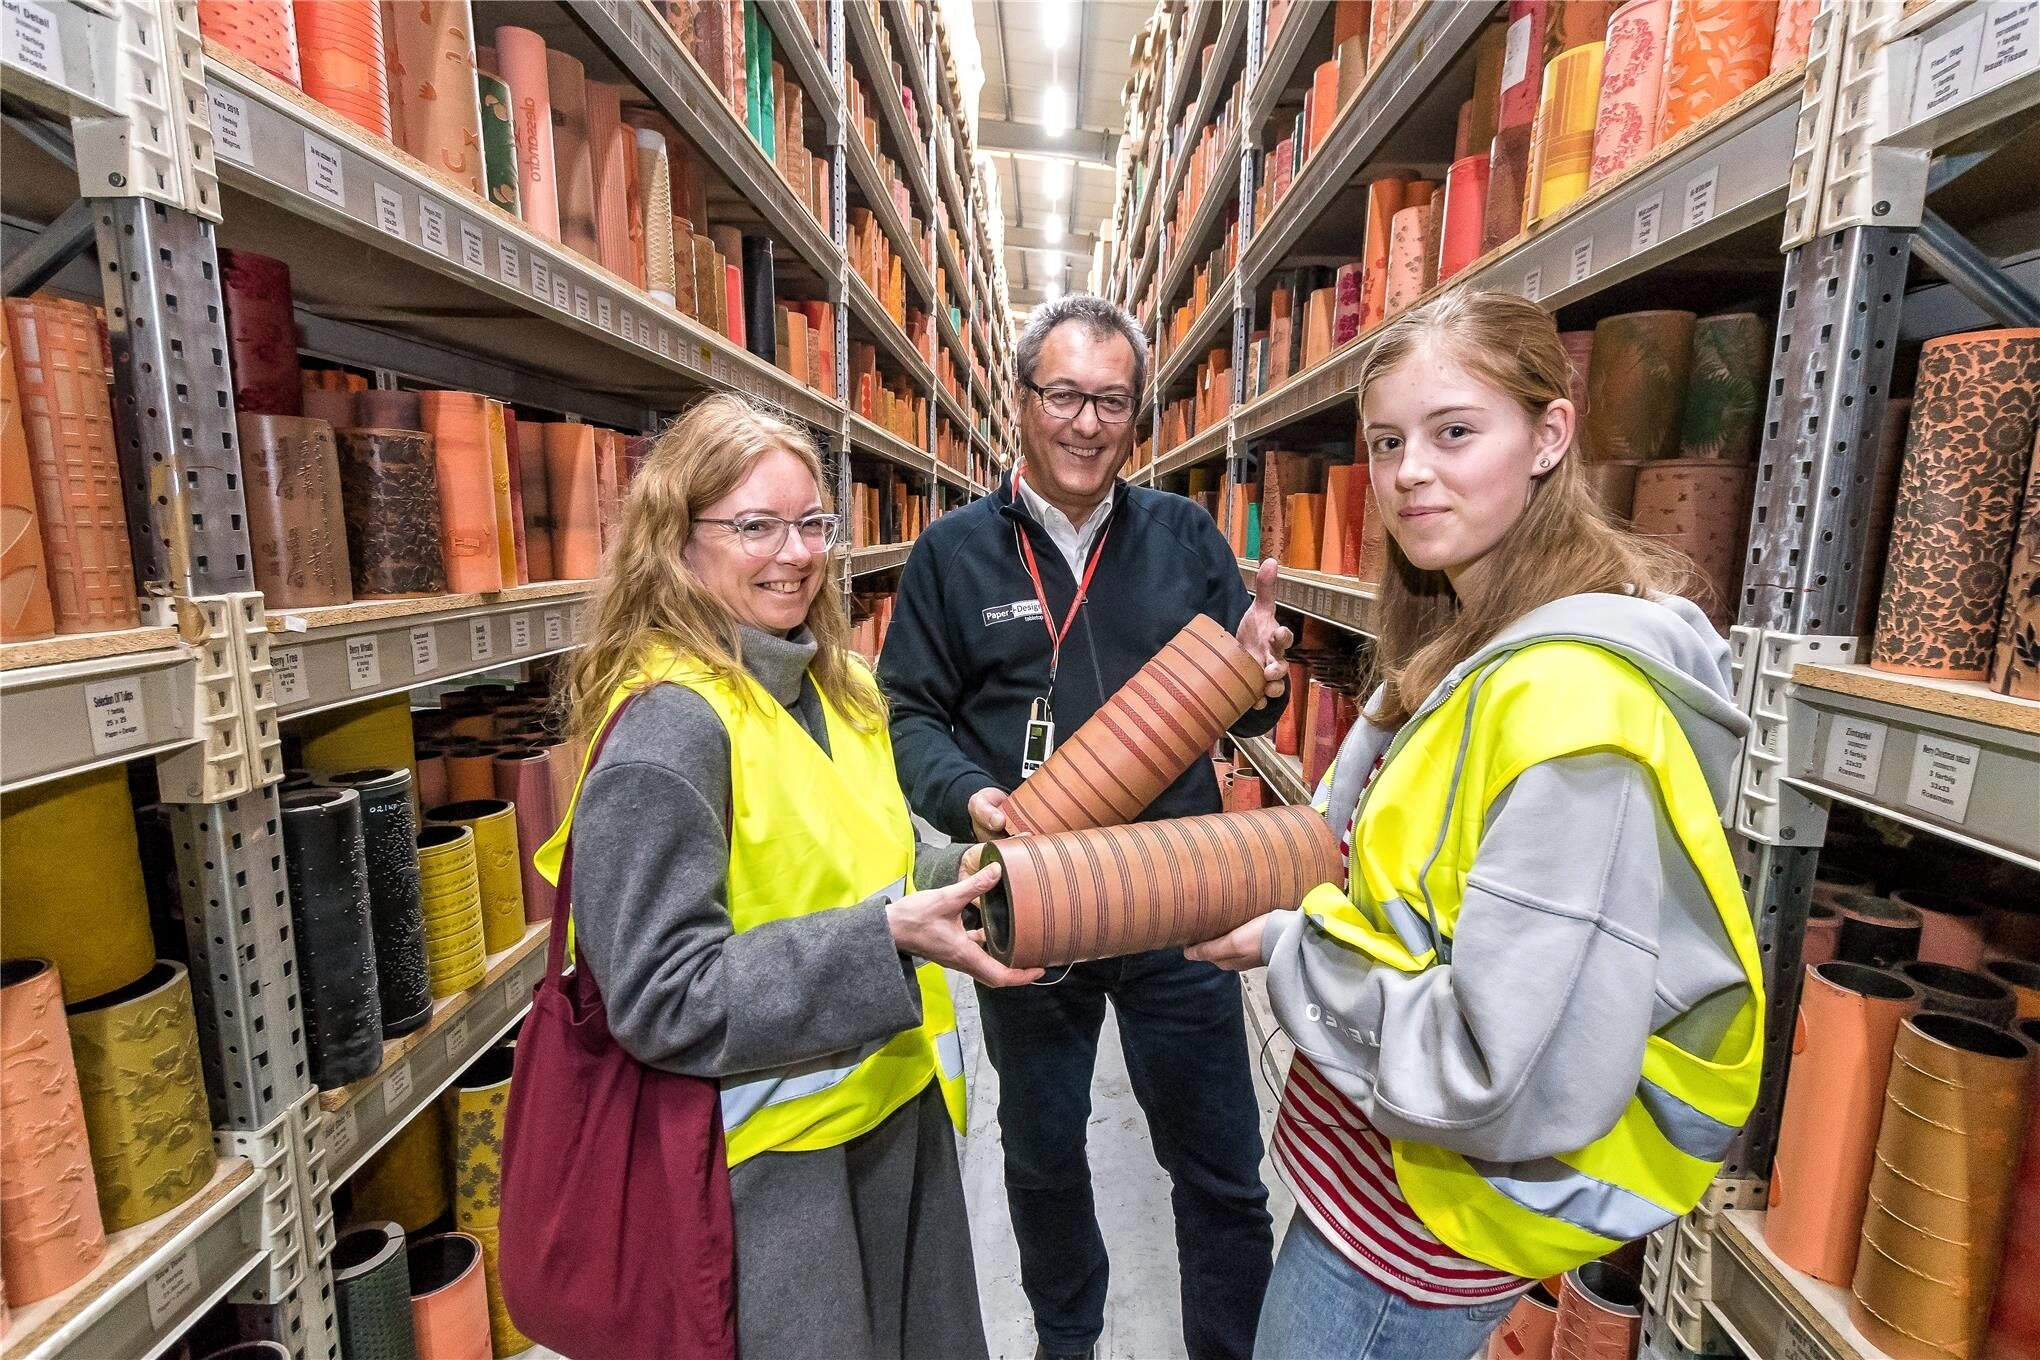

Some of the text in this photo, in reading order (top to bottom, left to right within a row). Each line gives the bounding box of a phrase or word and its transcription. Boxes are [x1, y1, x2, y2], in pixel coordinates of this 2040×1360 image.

[986, 608, 1009, 620] Paper
[1017, 603, 1041, 612] Desig
[285, 653, 298, 664] Tree
[93, 695, 113, 708] Selection
[1849, 750, 1867, 761] farbig
[1838, 766, 1866, 780] Rossmann
[1934, 771, 1956, 785] farbig
[1921, 789, 1954, 805] Rossmann
